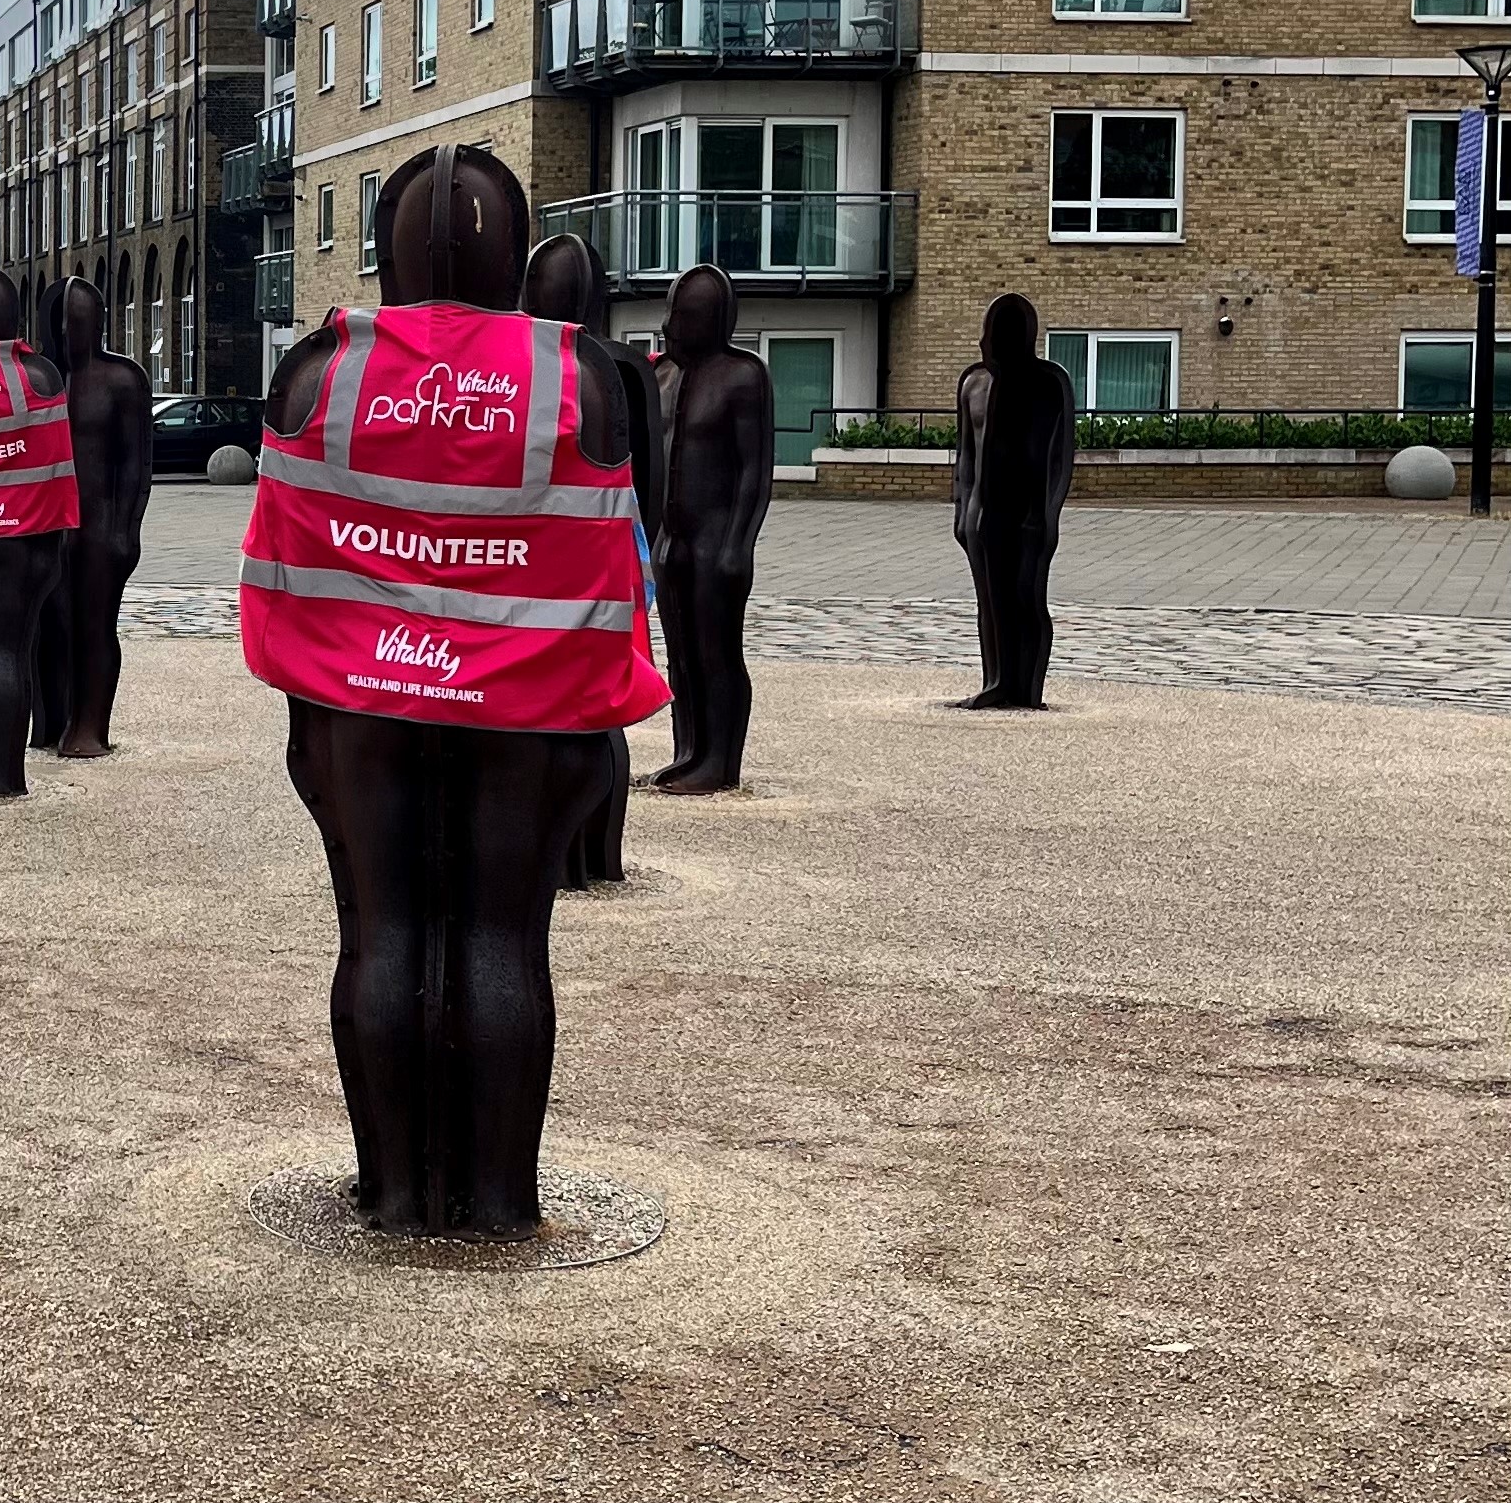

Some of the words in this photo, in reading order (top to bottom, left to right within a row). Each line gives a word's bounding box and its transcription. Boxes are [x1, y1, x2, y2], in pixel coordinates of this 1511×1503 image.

[364, 384, 515, 433] parkrun
[457, 369, 519, 403] Vitality
[329, 518, 529, 566] VOLUNTEER
[375, 623, 461, 682] Vitality
[347, 673, 380, 690] HEALTH
[380, 679, 401, 693] AND
[402, 682, 421, 696] LIFE
[422, 685, 485, 703] INSURANCE
